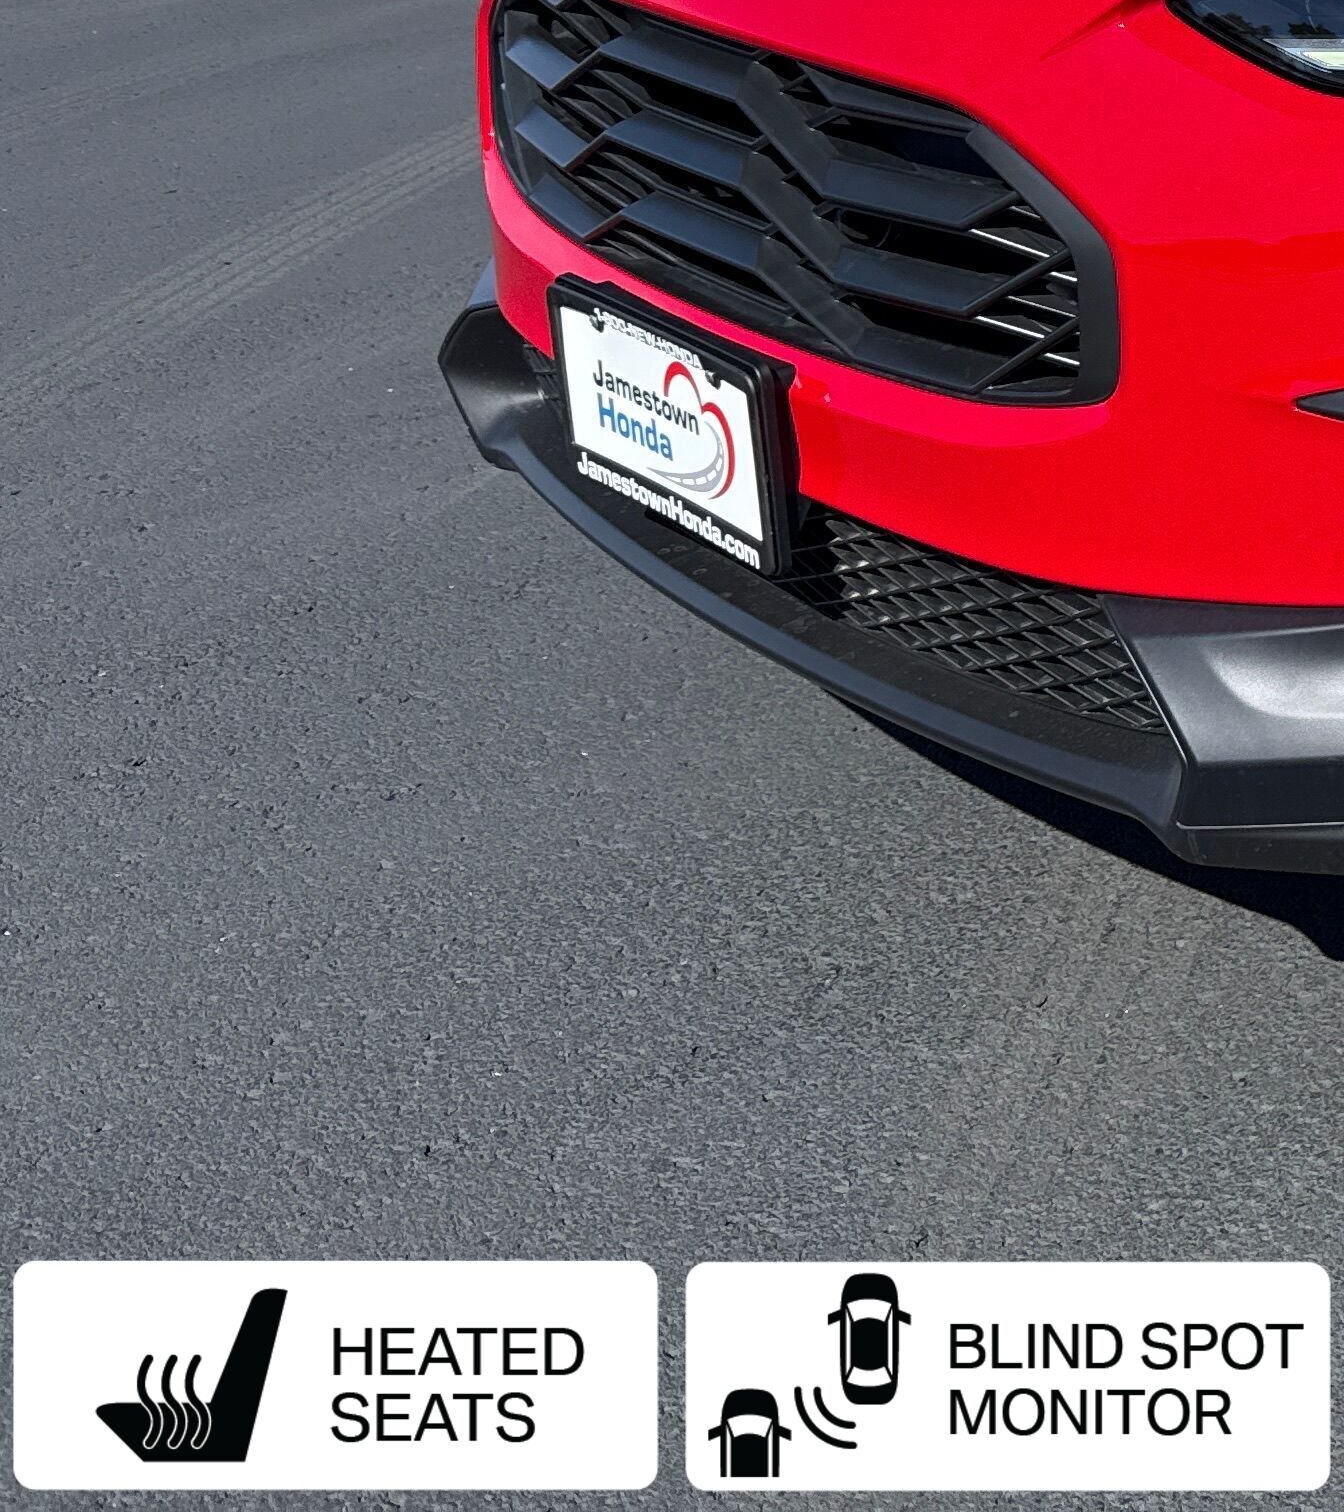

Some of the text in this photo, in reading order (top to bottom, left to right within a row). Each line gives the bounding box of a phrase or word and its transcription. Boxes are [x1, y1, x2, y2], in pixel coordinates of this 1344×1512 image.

[593, 359, 700, 436] Jamestown
[597, 391, 674, 462] Honda
[576, 450, 761, 570] JamestownHonda.com
